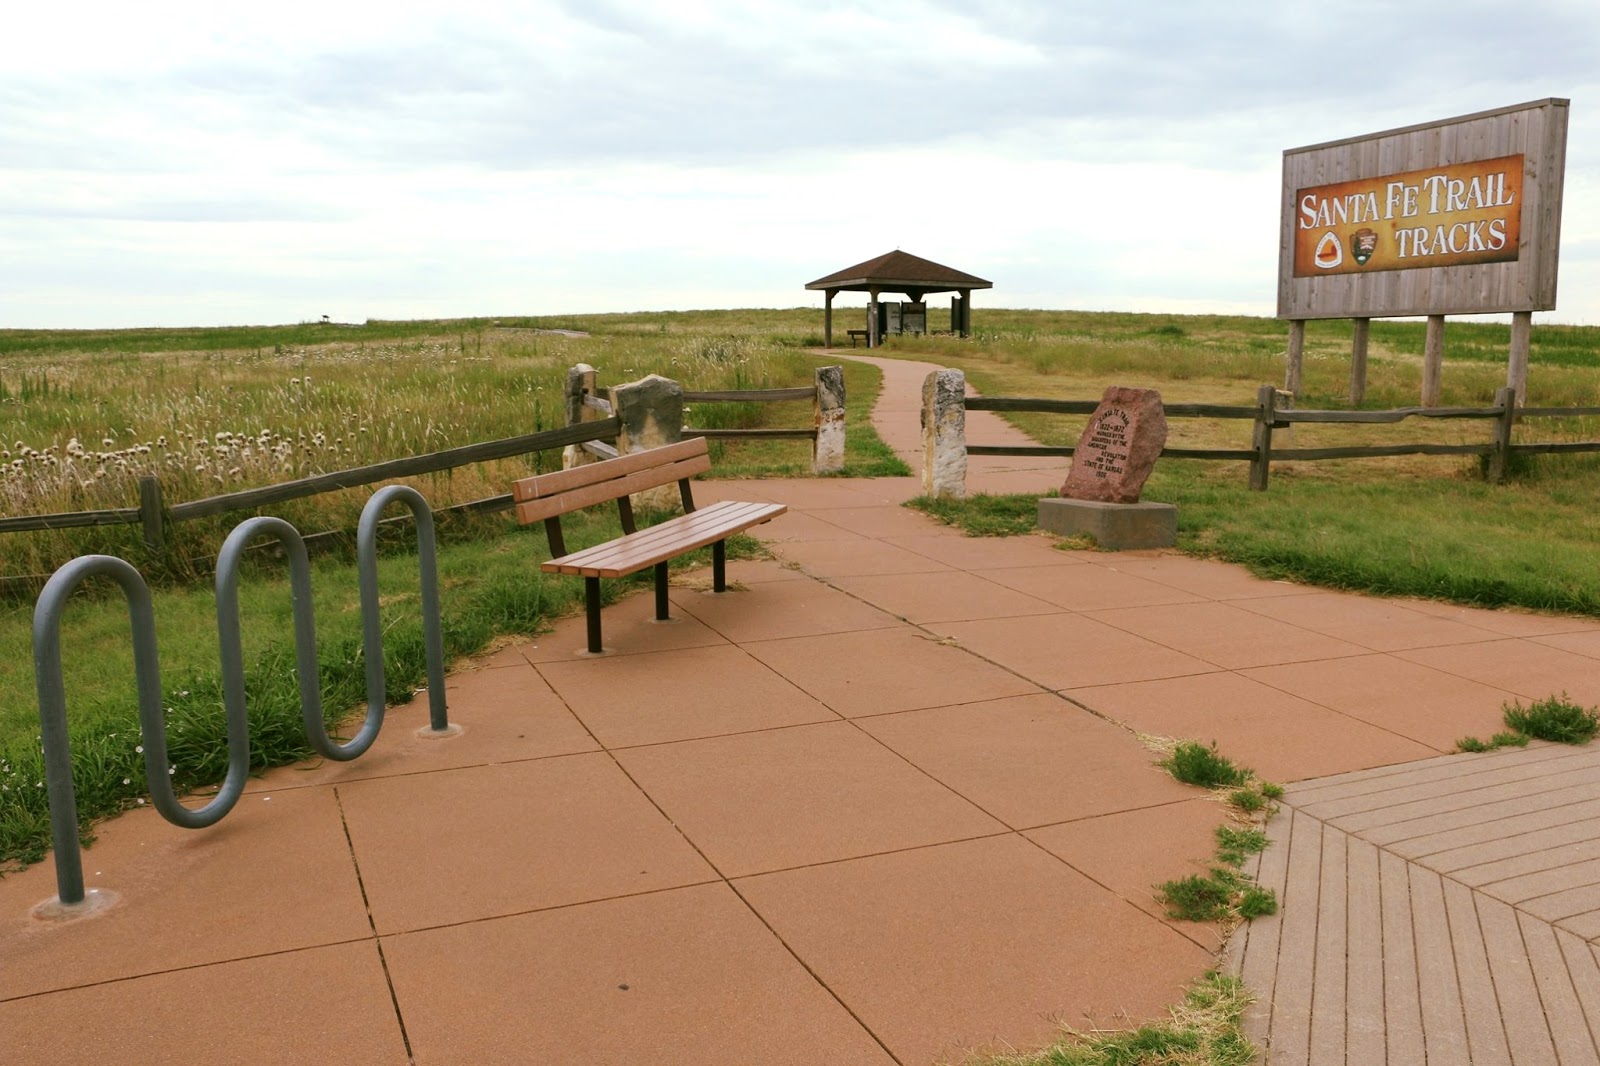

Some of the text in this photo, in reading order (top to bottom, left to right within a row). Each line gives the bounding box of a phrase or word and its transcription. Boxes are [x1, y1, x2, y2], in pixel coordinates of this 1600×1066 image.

[1300, 173, 1516, 231] SANTA FE TRAIL
[1395, 218, 1507, 258] TRACKS
